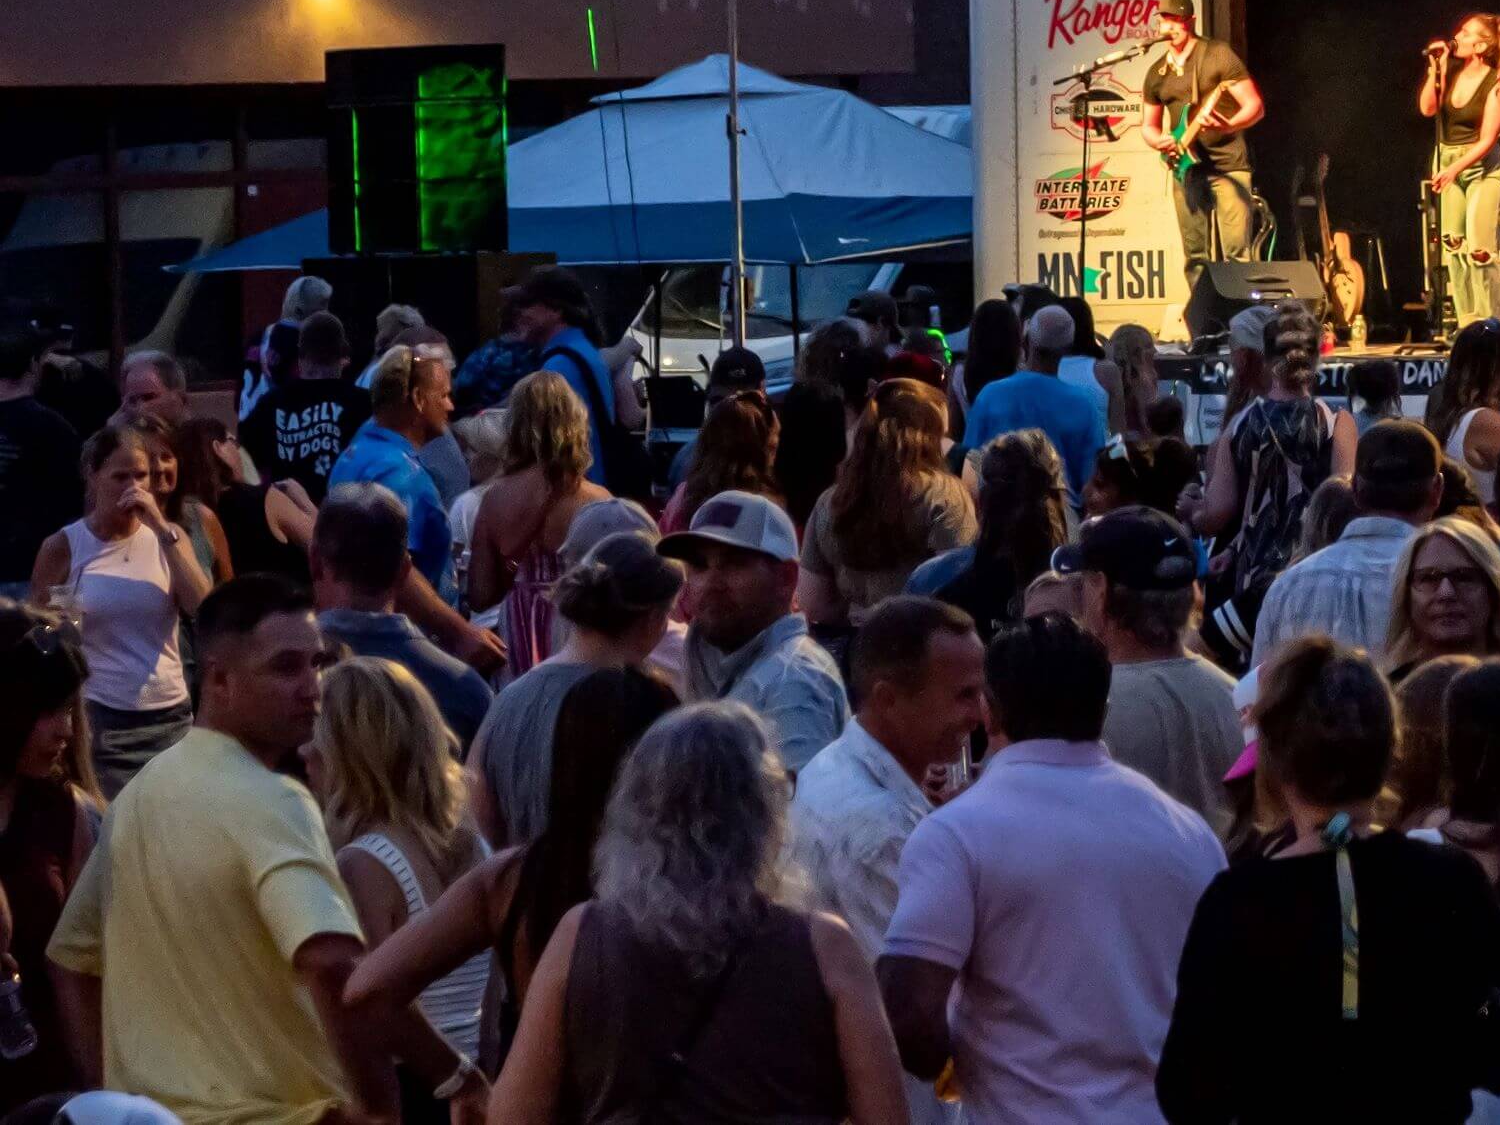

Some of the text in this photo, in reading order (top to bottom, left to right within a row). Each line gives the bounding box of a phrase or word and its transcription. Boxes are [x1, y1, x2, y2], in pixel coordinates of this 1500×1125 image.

[1093, 103, 1141, 113] HARDWARE
[1100, 250, 1165, 300] FISH
[278, 437, 340, 462] BY DOGS
